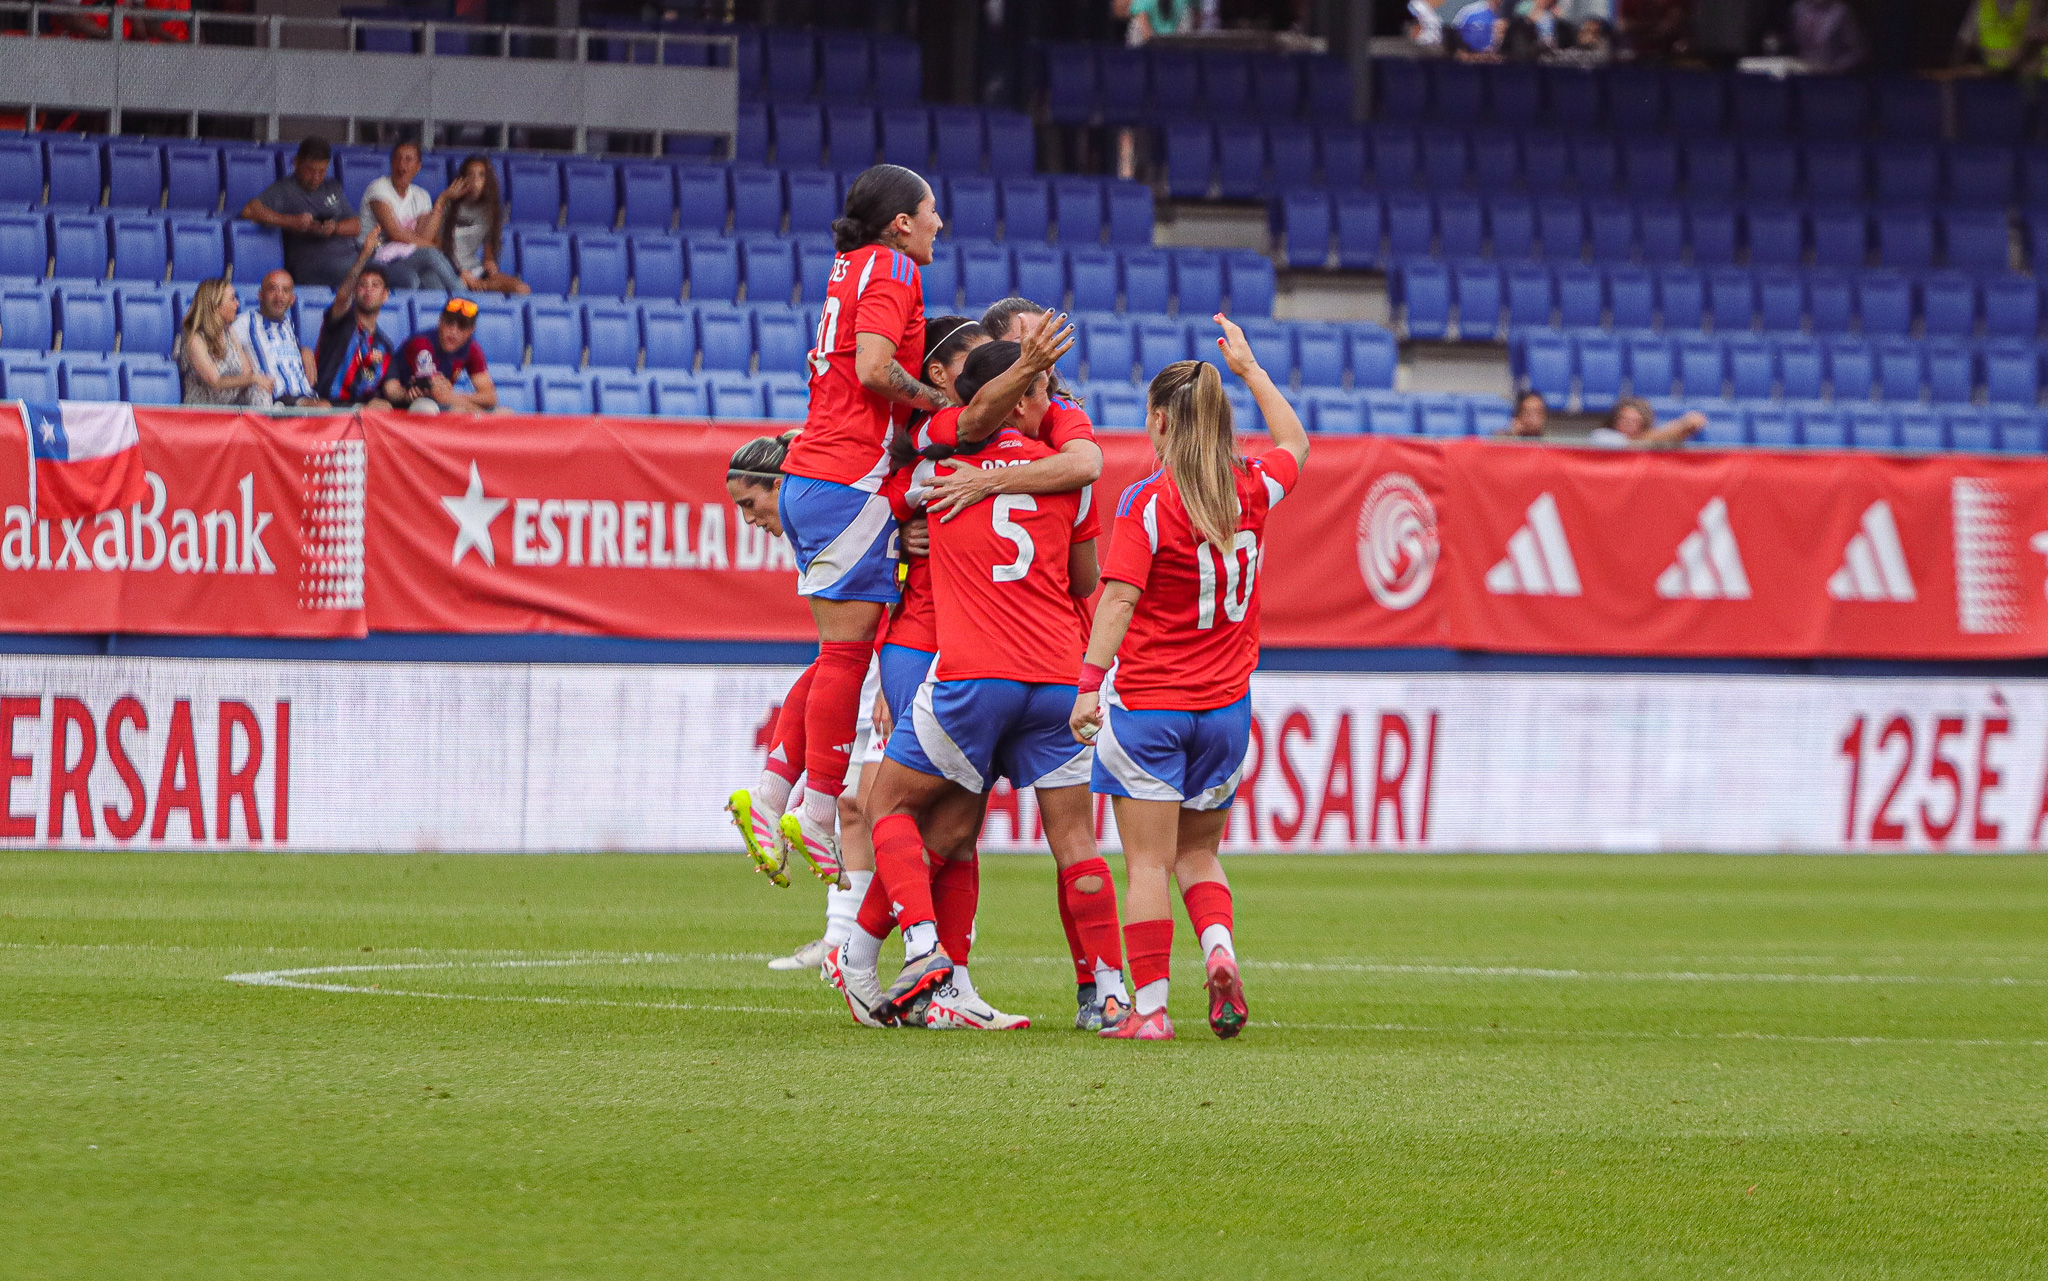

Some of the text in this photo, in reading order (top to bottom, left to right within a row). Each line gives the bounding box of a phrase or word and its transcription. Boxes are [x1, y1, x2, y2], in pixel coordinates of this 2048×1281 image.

[512, 498, 729, 570] ESTRELLA
[992, 494, 1038, 582] 5
[1197, 529, 1259, 629] 10
[0, 695, 291, 843] ERSARI
[1840, 688, 2011, 846] 125È
